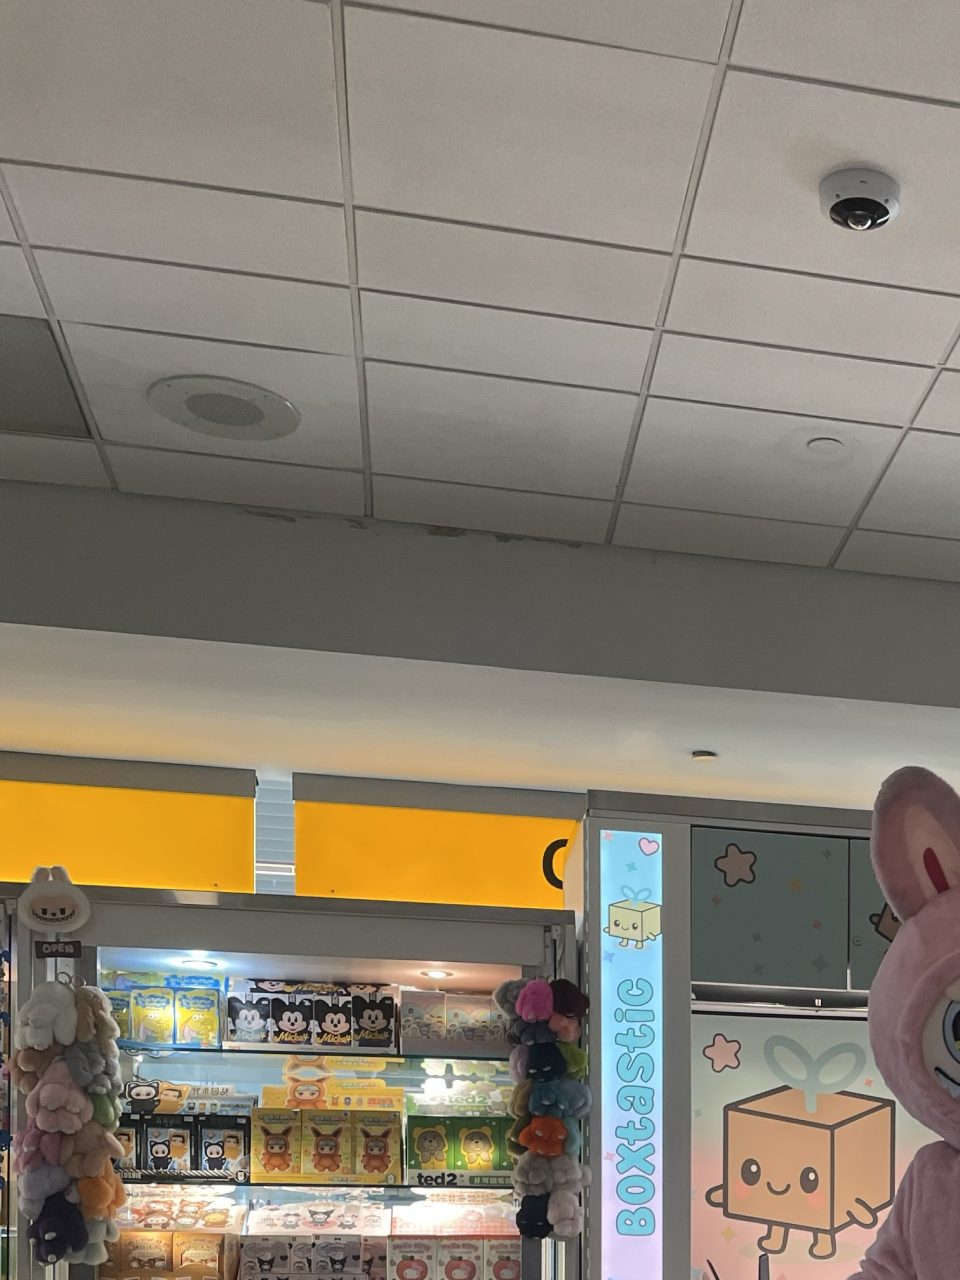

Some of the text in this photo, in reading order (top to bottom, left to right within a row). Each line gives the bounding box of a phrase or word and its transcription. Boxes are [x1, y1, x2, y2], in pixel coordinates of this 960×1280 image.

[43, 943, 74, 953] OPEN
[278, 1031, 309, 1042] Mickey
[320, 1032, 352, 1043] Mickey
[357, 1030, 389, 1042] Mickey
[416, 1173, 458, 1186] ted2
